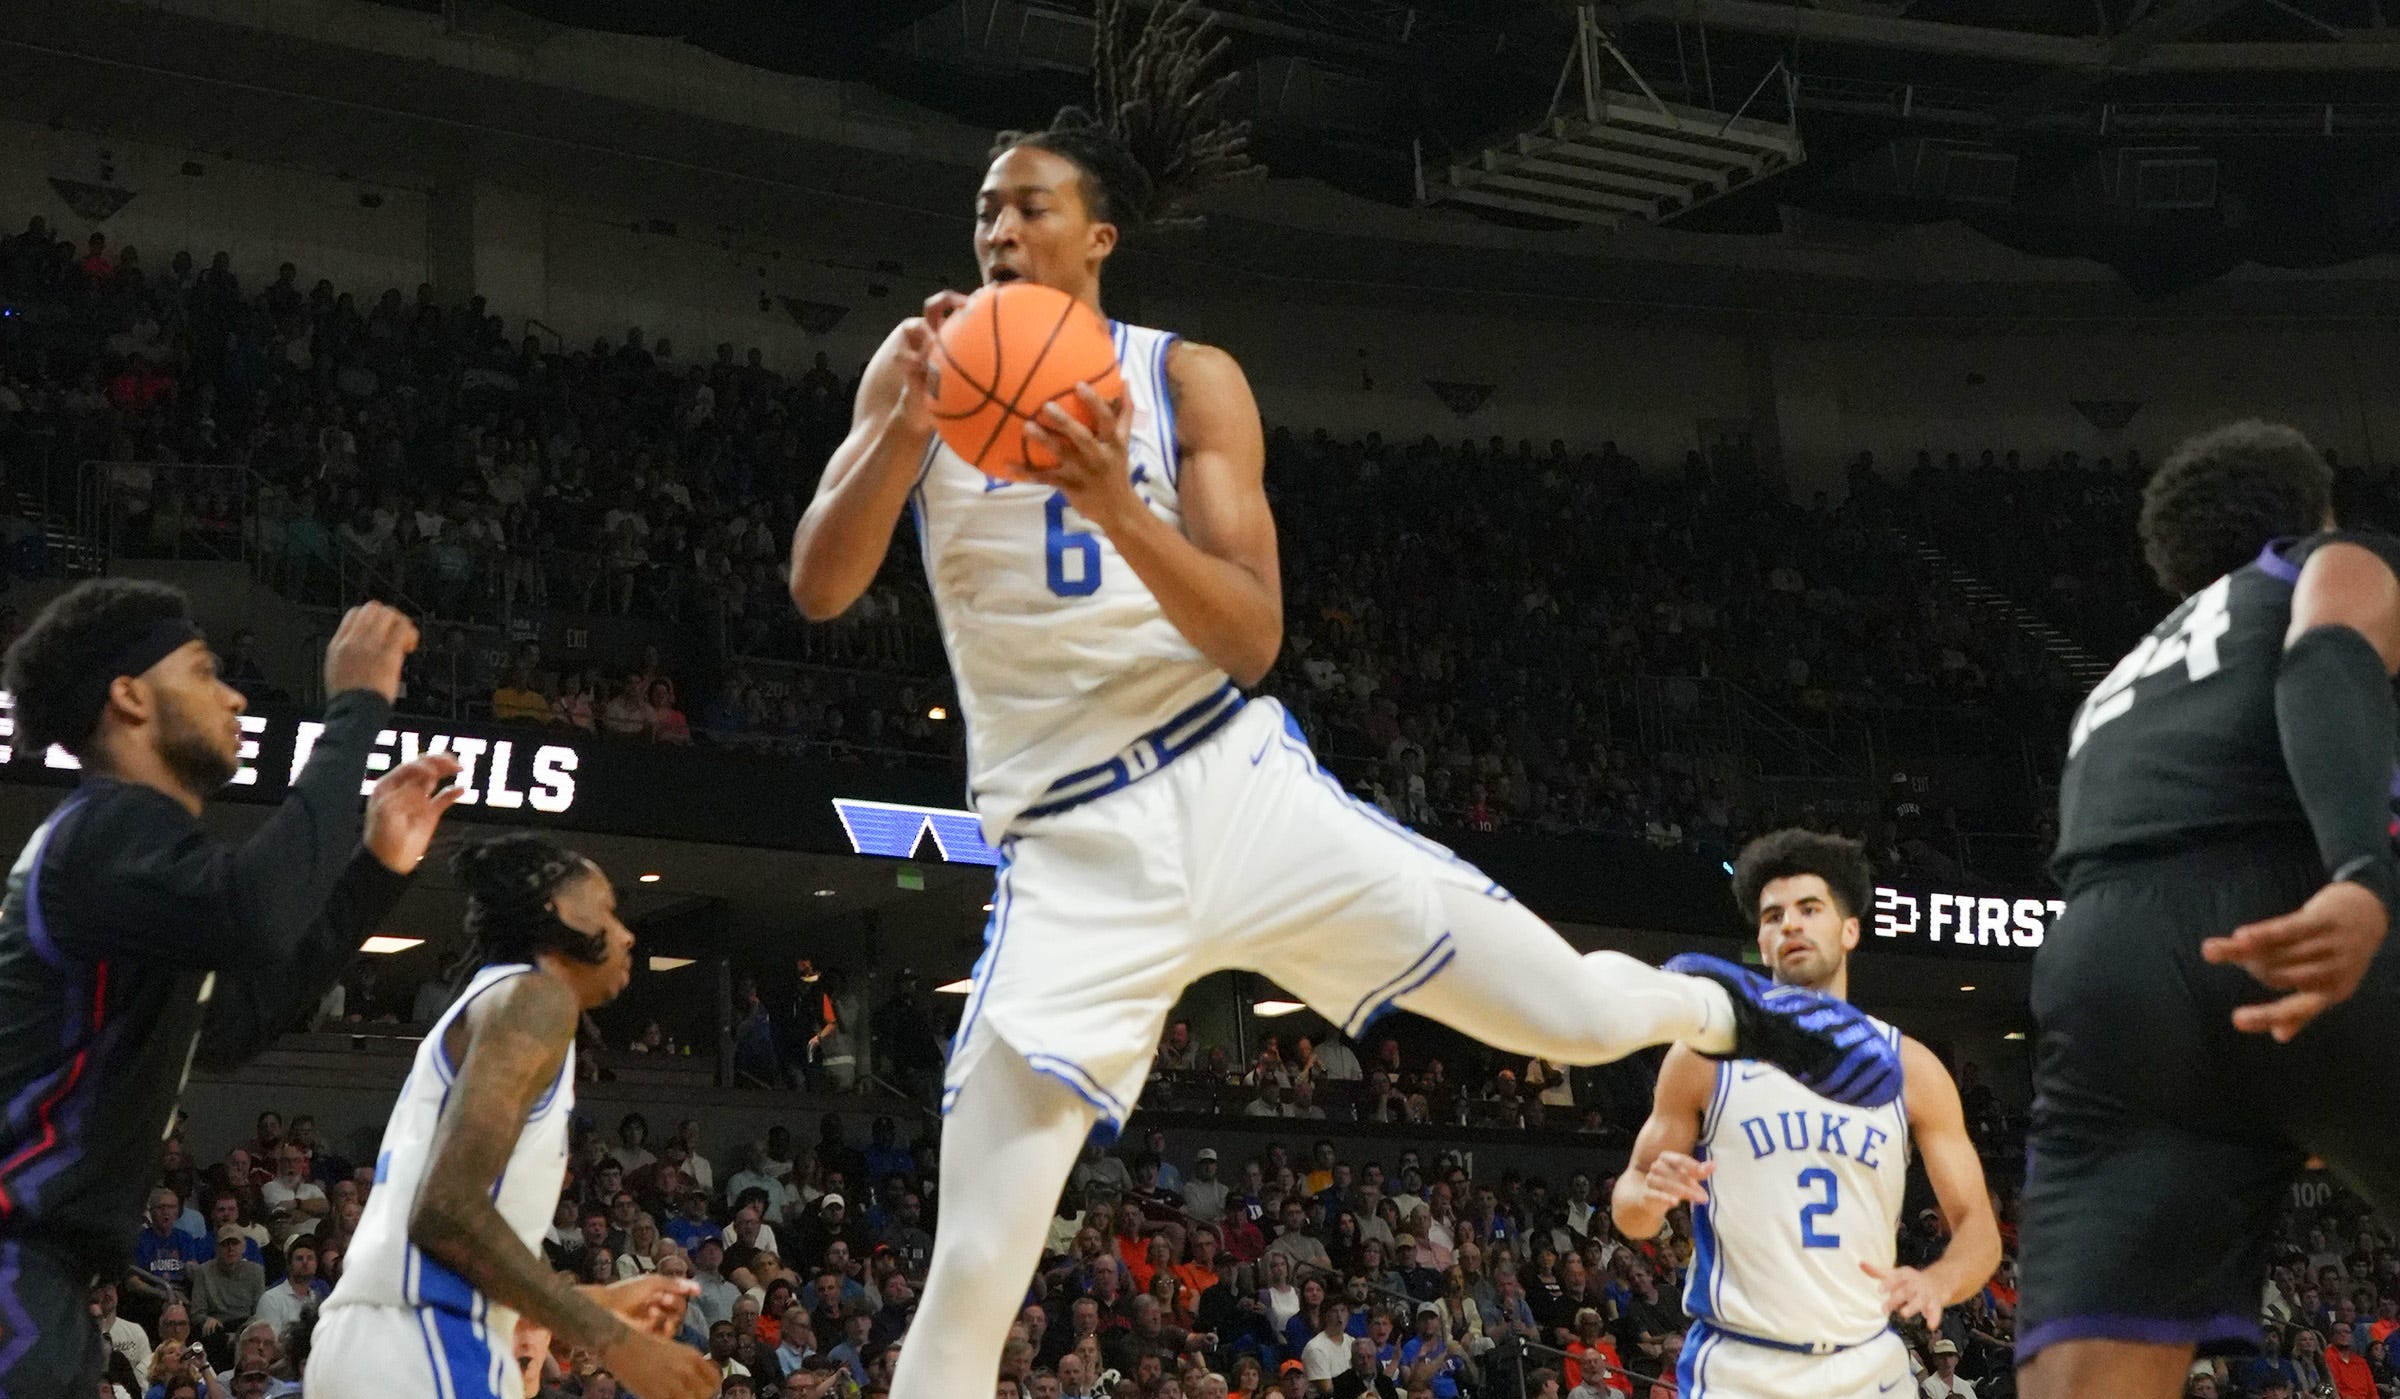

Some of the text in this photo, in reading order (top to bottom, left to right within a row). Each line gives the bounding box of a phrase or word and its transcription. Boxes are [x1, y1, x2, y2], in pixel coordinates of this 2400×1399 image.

[1045, 489, 1101, 597] 6
[1740, 1111, 1887, 1170] DUKE
[1798, 1167, 1840, 1248] 2
[2290, 1182, 2331, 1208] 100
